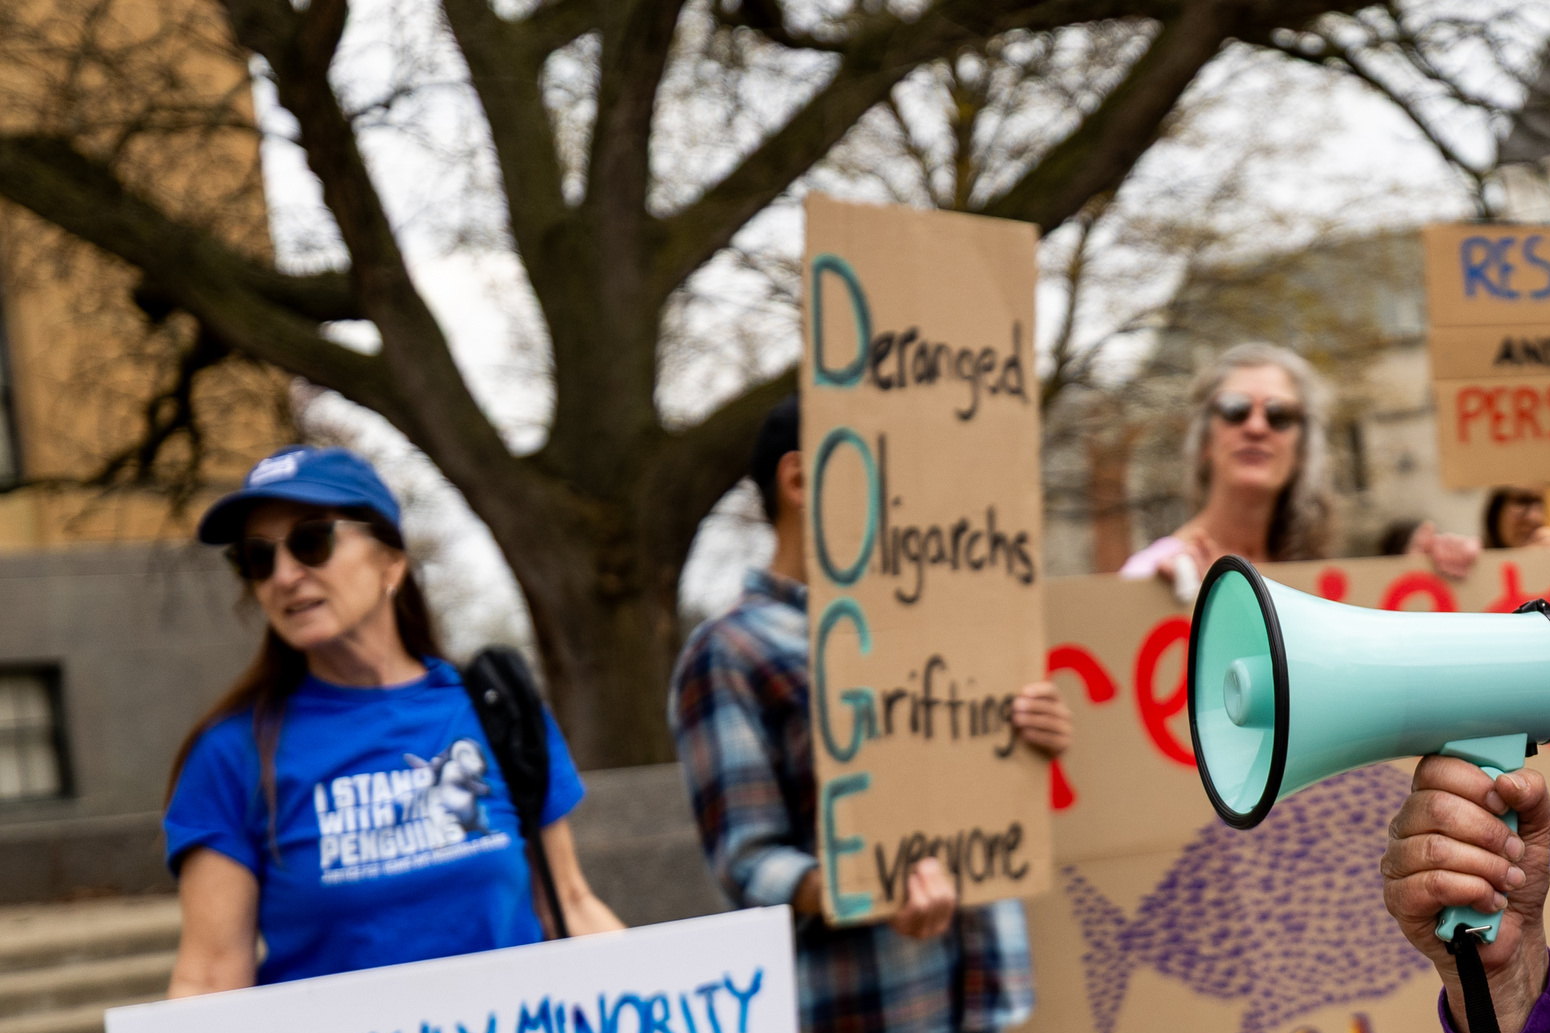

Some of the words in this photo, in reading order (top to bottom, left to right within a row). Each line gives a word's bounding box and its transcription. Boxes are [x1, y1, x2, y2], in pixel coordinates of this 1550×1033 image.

[811, 254, 1028, 421] Deranged
[813, 426, 1034, 605] Oligarchs
[815, 596, 1016, 758] Grifting
[314, 782, 329, 813] I
[331, 767, 435, 809] STAND
[318, 799, 396, 835] WITH
[320, 819, 467, 870] PENGUINS
[822, 772, 1028, 919] Everyone
